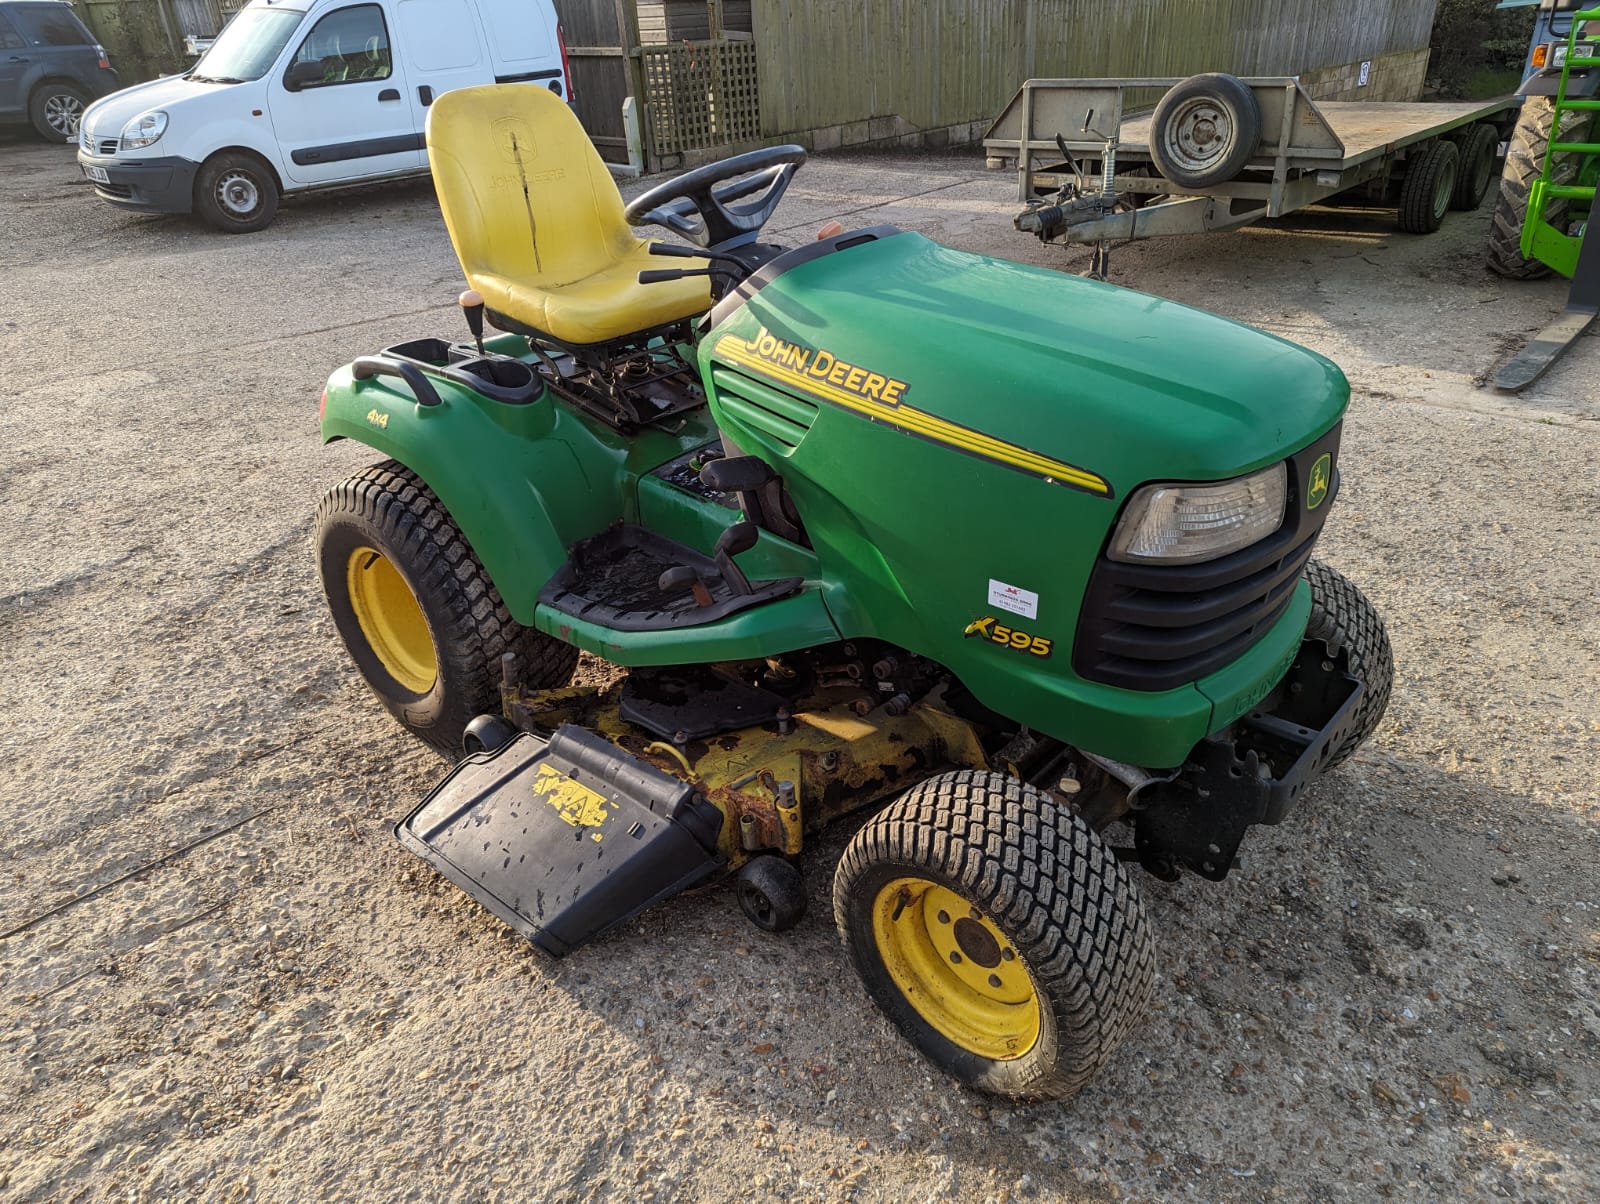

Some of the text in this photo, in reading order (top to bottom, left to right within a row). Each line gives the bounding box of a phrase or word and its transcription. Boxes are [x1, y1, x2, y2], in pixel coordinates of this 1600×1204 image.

[746, 326, 906, 405] JOHN DEERE
[964, 616, 1052, 656] X595
